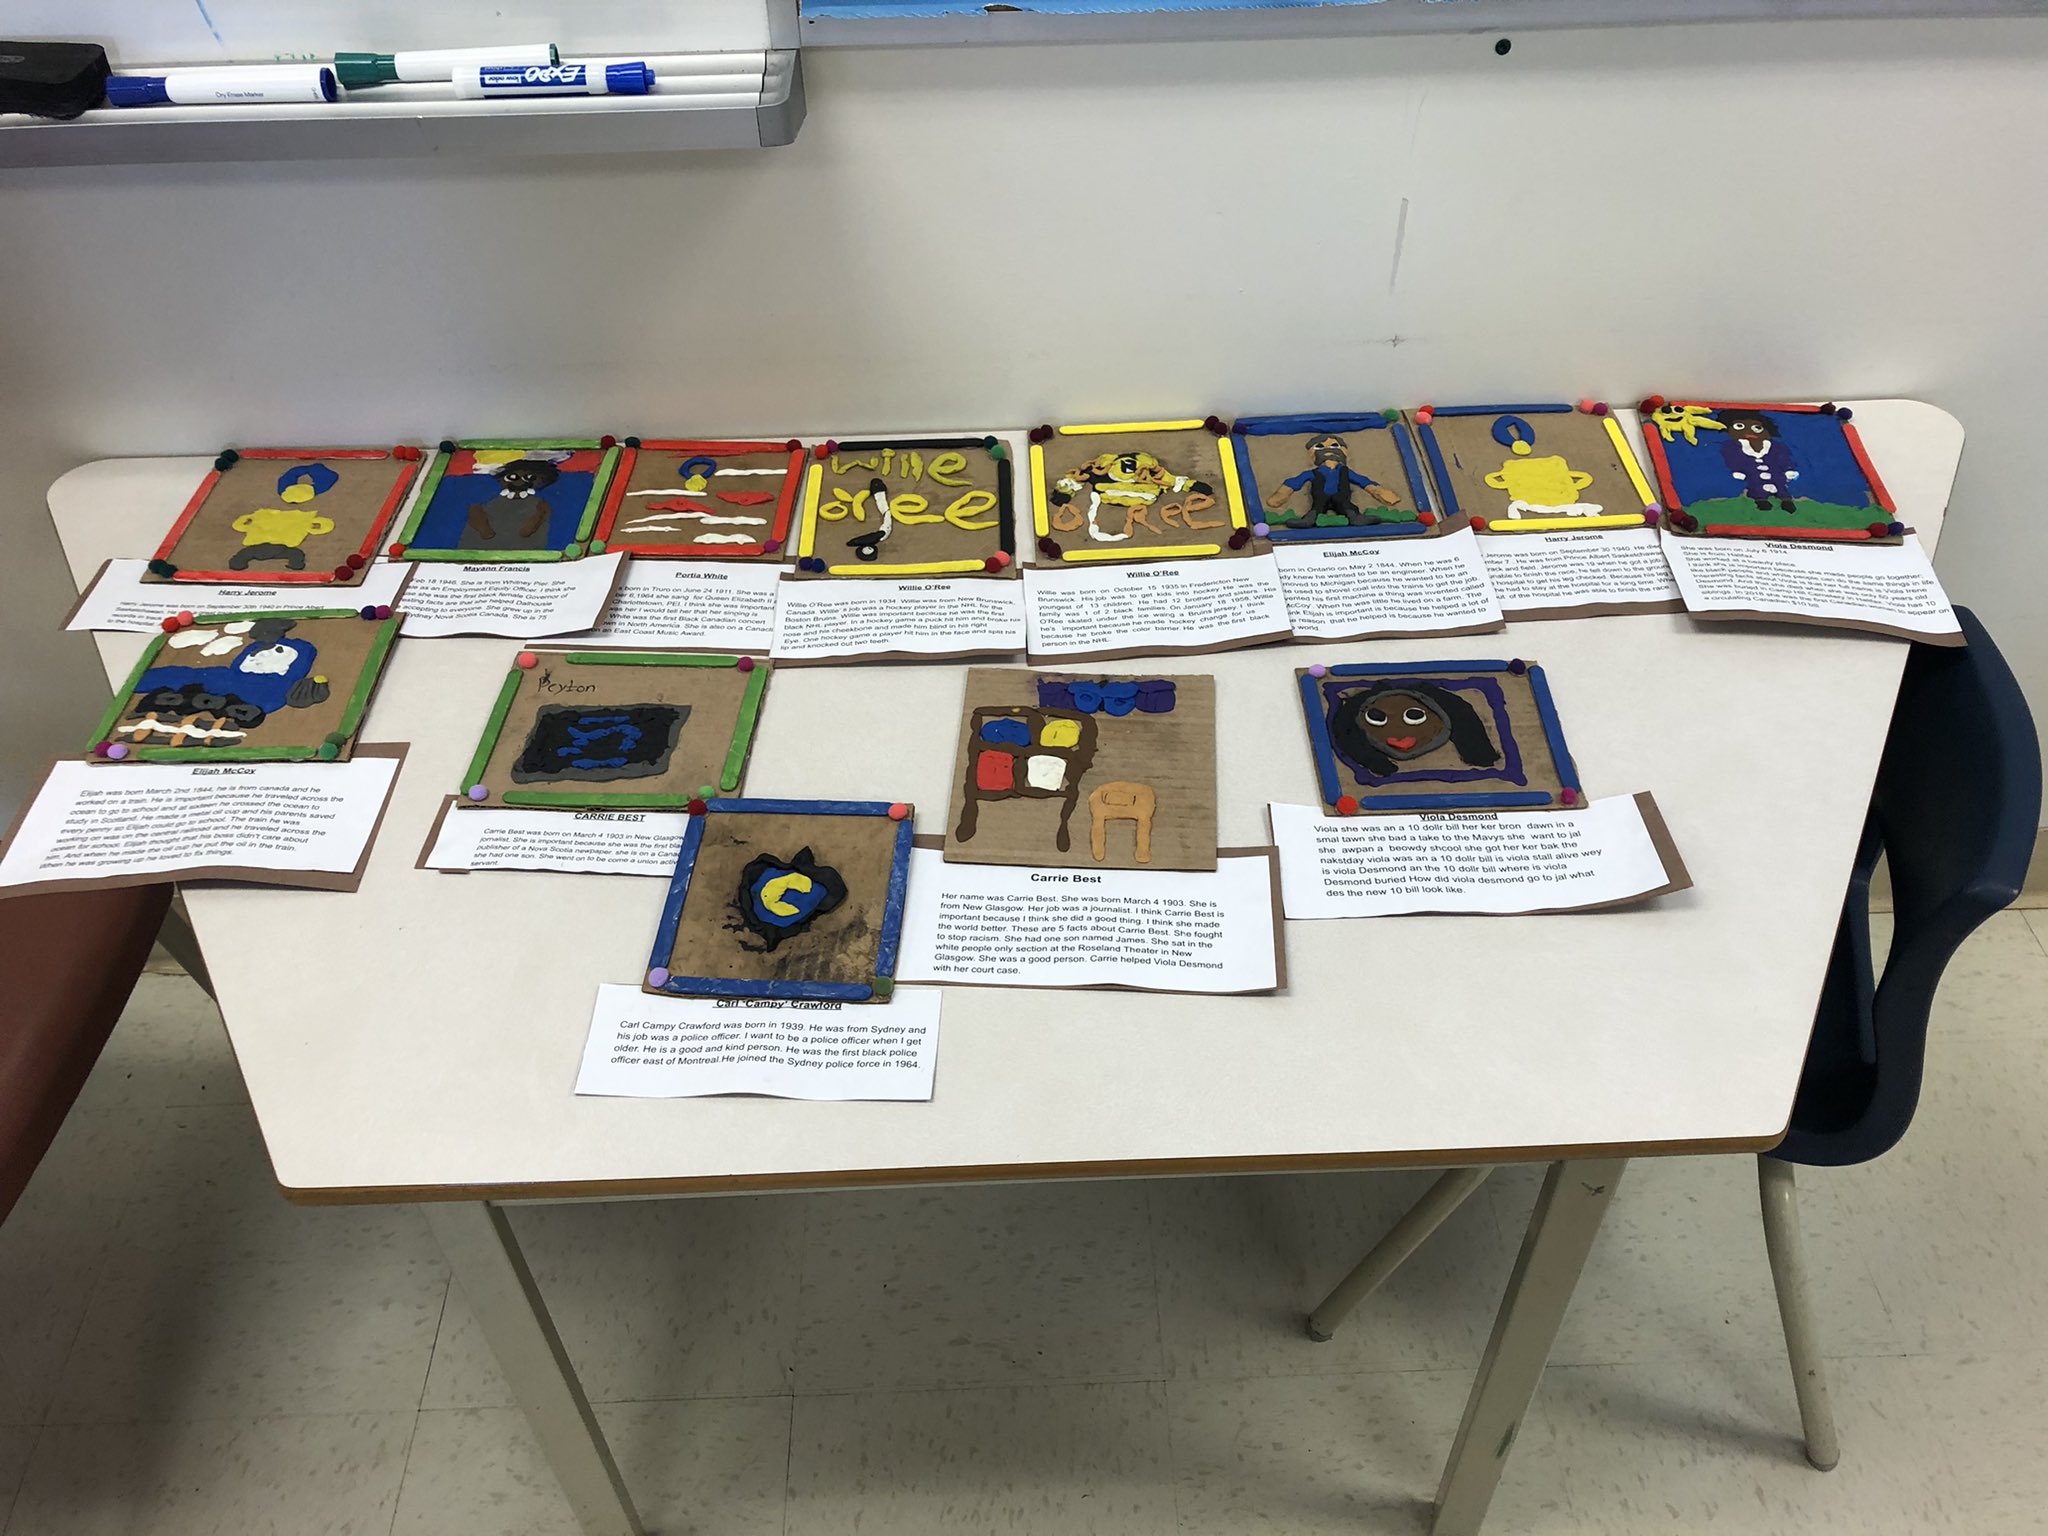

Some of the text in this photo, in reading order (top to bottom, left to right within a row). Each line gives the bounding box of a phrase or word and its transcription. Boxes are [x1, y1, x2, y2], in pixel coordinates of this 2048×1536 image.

[525, 66, 581, 82] EXPO
[1790, 543, 1834, 551] Desmond
[192, 768, 220, 776] Elijah
[574, 812, 646, 822] CARRIE BEST
[1448, 812, 1498, 820] Desmond
[1313, 825, 1338, 833] Viola
[1445, 823, 1459, 831] bill
[1030, 873, 1102, 883] Carrie Best
[1035, 894, 1058, 902] Best.
[1123, 896, 1151, 905] March
[1162, 898, 1186, 906] 1903.
[1188, 899, 1207, 907] She
[984, 903, 1024, 913] Glasgow.
[1045, 905, 1060, 913] job
[1089, 904, 1132, 913] journalist.
[1140, 907, 1162, 915] think
[1164, 908, 1192, 917] Carrie
[1193, 909, 1214, 917] Best
[717, 1000, 738, 1008] Carl
[791, 1000, 842, 1010] Crawford
[619, 1020, 640, 1028] Carl
[641, 1021, 676, 1031] Campy
[678, 1021, 721, 1030] Crawford
[780, 1021, 805, 1031] 1939.
[808, 1023, 822, 1032] He
[846, 1024, 868, 1033] from
[870, 1025, 906, 1035] Sydney
[616, 1032, 630, 1040] his
[631, 1032, 648, 1042] job
[679, 1033, 709, 1042] police
[710, 1032, 741, 1040] officer.
[775, 1032, 785, 1040] to
[786, 1033, 799, 1042] be
[810, 1035, 839, 1044] police
[840, 1036, 871, 1044] officer
[906, 1038, 921, 1046] get
[613, 1044, 639, 1052] older.
[642, 1044, 657, 1053] He
[658, 1045, 667, 1053] is
[678, 1045, 703, 1055] good
[704, 1044, 723, 1052] and
[724, 1043, 745, 1051] kind
[746, 1044, 782, 1052] person.
[785, 1045, 800, 1054] He
[824, 1048, 839, 1056] the
[841, 1048, 859, 1056] first
[861, 1048, 887, 1056] black
[888, 1048, 917, 1057] police
[610, 1055, 641, 1064] officer
[642, 1057, 664, 1065] east
[665, 1056, 676, 1065] of
[736, 1053, 767, 1063] joined
[768, 1055, 784, 1064] the
[786, 1056, 823, 1069] Sydney
[824, 1060, 854, 1069] police
[856, 1059, 880, 1068] force
[894, 1059, 920, 1068] 1964.
